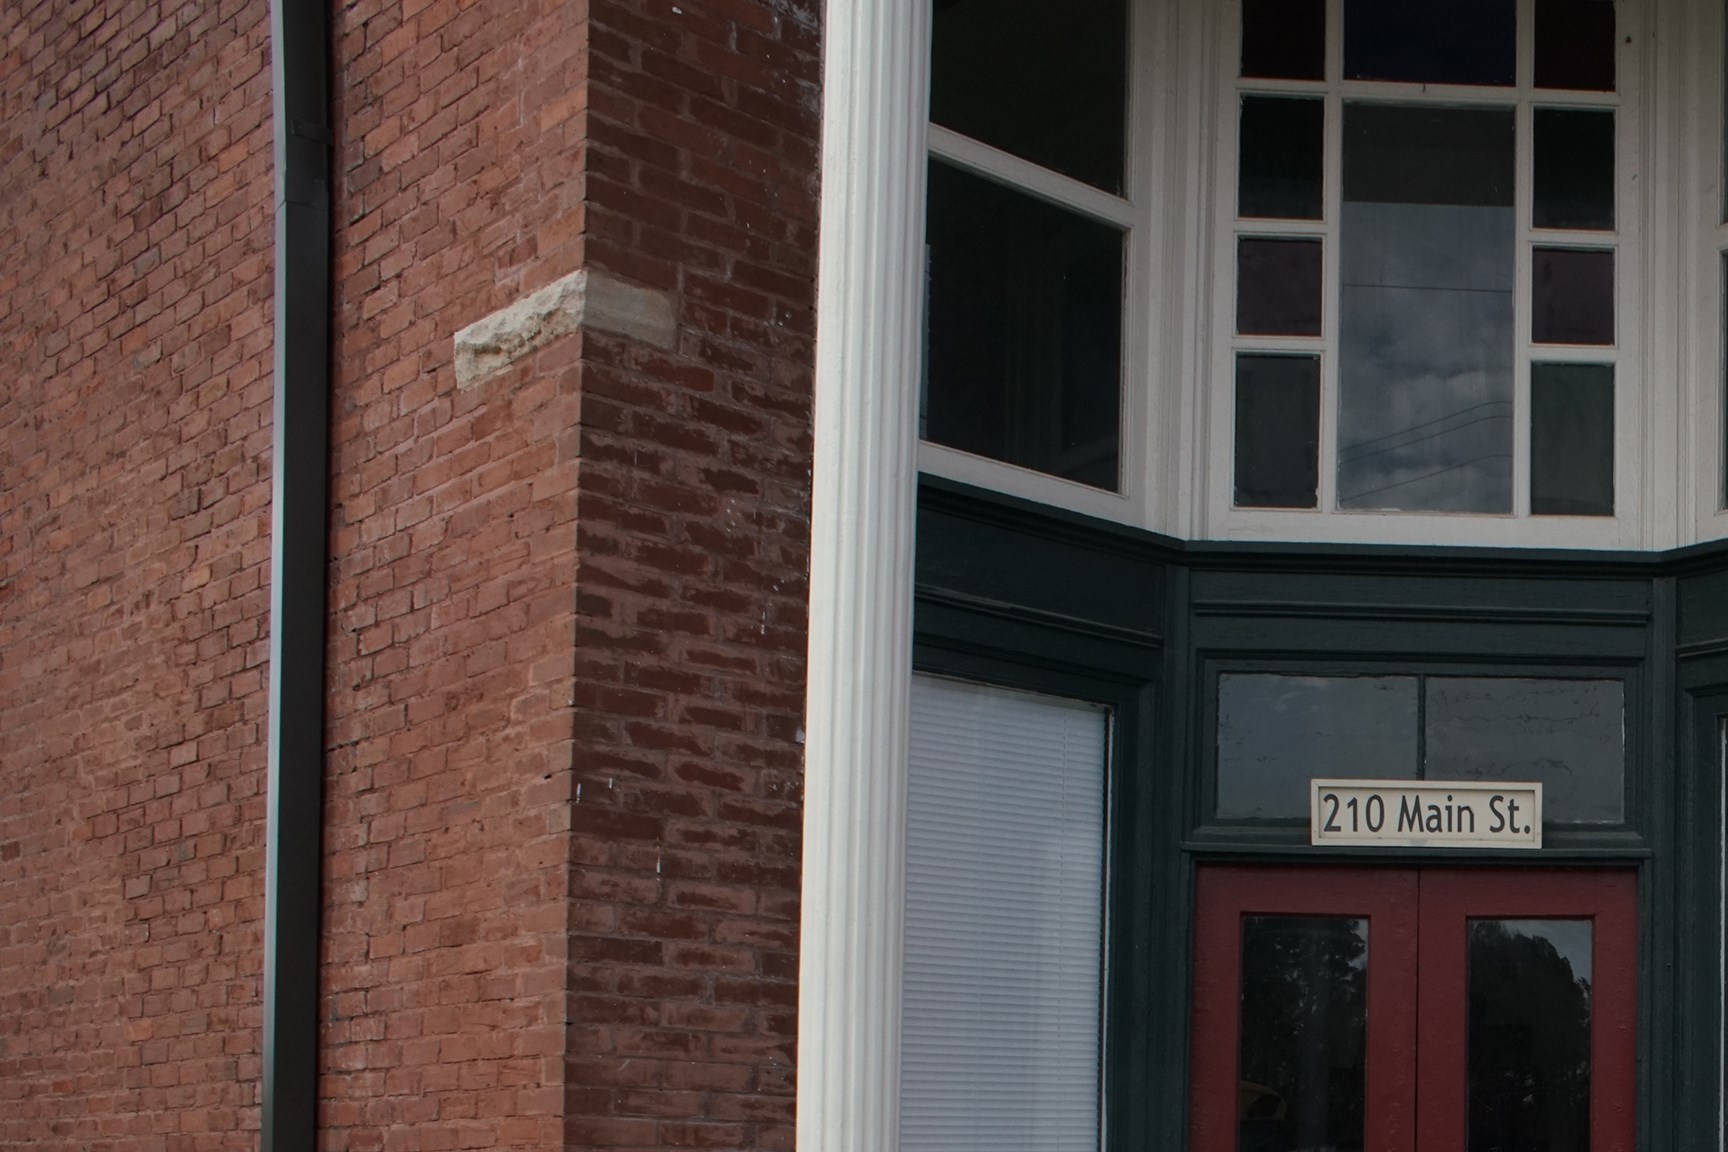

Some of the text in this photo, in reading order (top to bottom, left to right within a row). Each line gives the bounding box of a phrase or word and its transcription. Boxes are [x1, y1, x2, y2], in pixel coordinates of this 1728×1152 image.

[1323, 794, 1531, 835] 210 Main St.
